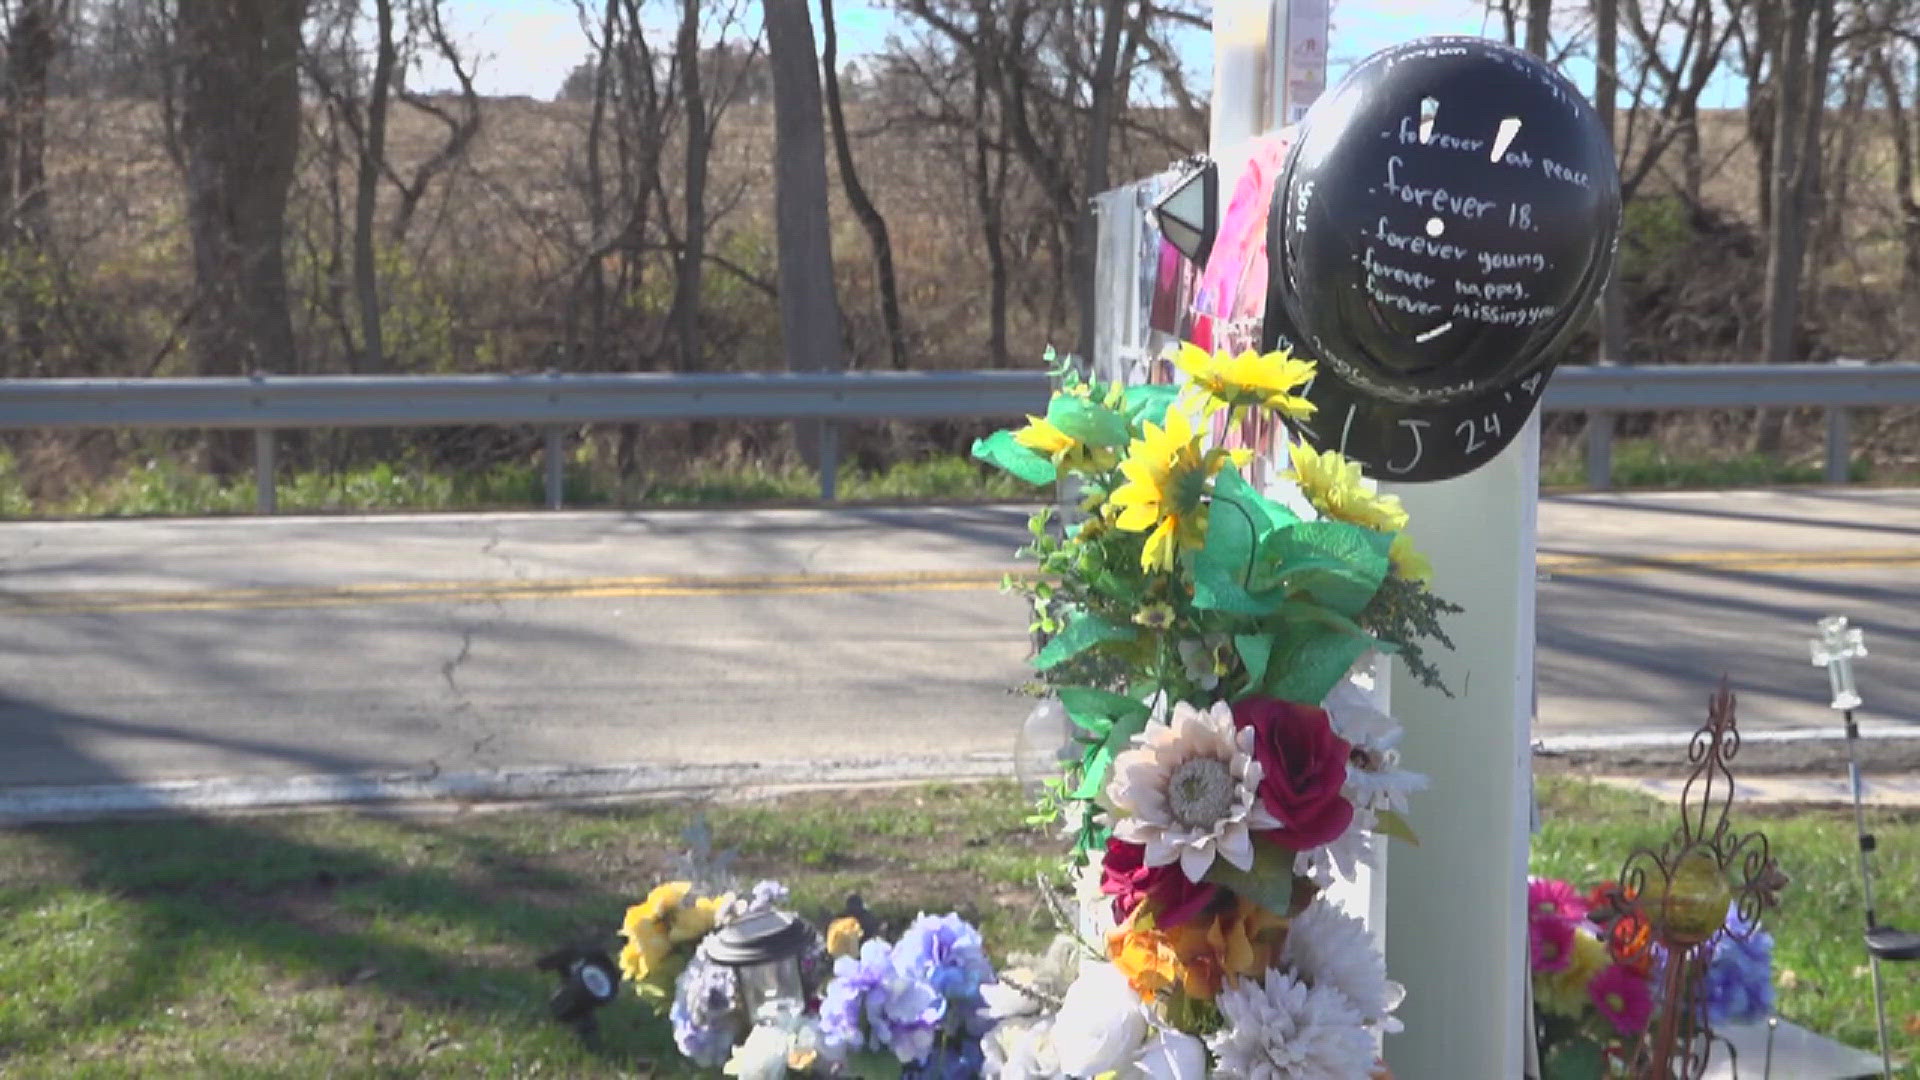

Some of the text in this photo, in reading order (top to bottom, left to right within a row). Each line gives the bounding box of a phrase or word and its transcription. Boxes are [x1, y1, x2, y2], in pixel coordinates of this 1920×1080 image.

[1399, 116, 1484, 151] forever
[1505, 151, 1533, 169] at
[1384, 156, 1497, 220] forever
[1375, 215, 1468, 261] forever
[1362, 246, 1436, 290] forever
[1365, 272, 1442, 316] forever
